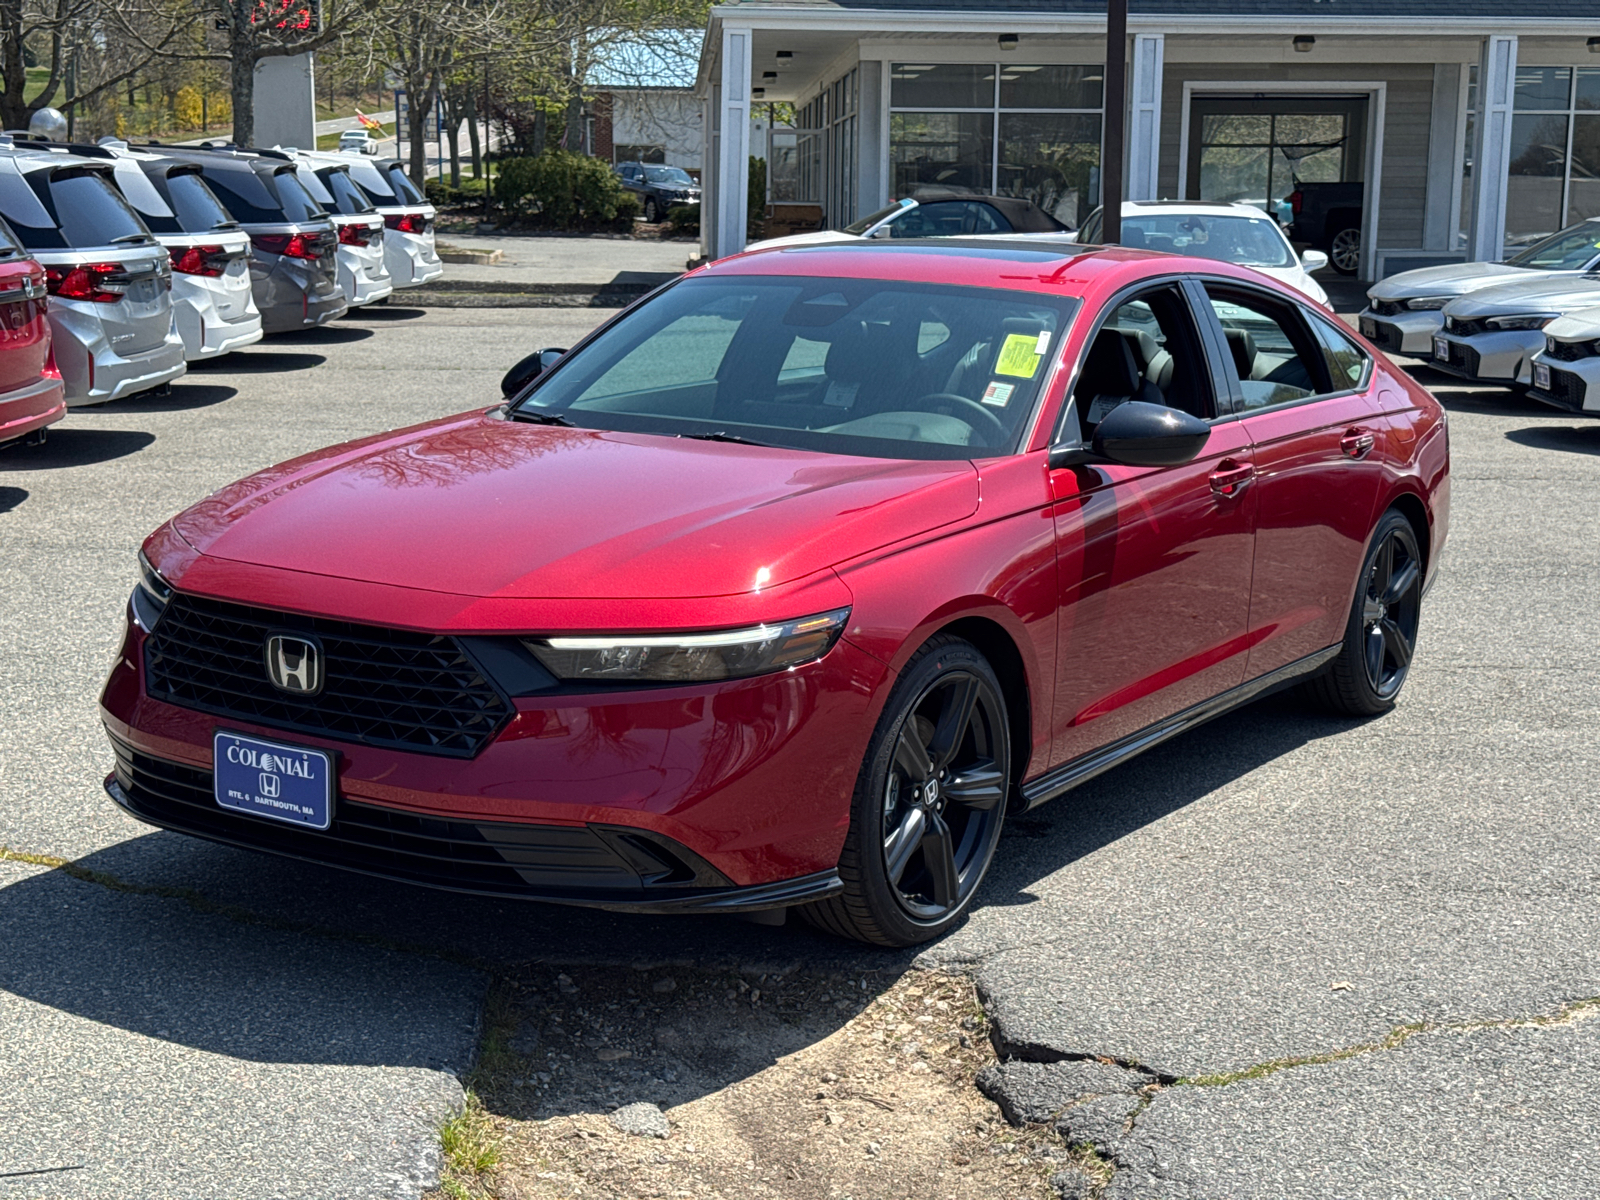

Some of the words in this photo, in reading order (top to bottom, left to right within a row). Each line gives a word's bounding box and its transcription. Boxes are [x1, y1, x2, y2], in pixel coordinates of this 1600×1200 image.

[227, 745, 314, 779] COLONIAL
[228, 789, 244, 800] RTE.
[244, 793, 250, 801] 6
[254, 795, 301, 813] DARTMOUTH,
[302, 806, 314, 815] MA
